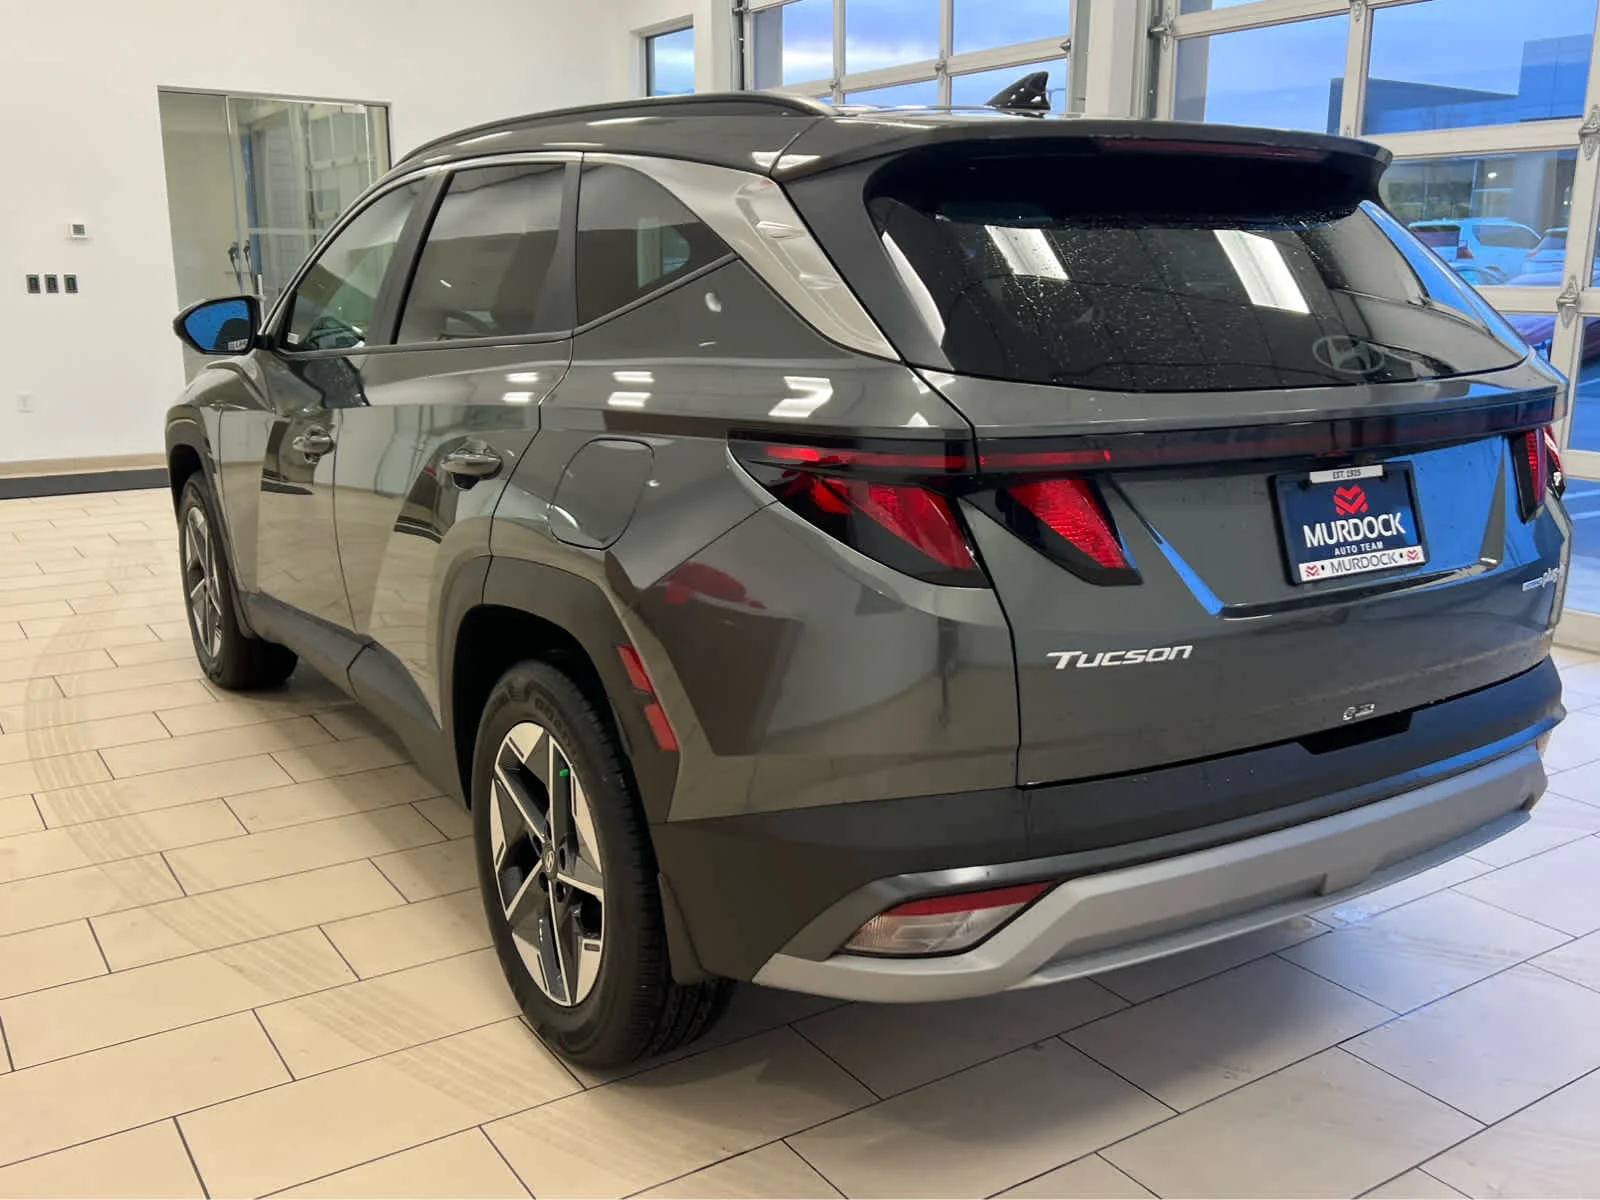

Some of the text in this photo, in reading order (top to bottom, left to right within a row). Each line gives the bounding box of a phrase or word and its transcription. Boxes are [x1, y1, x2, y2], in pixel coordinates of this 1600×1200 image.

[1303, 512, 1406, 548] MURDOCK
[1334, 541, 1384, 556] AUTO TEAM
[1330, 552, 1398, 574] MURDOCK
